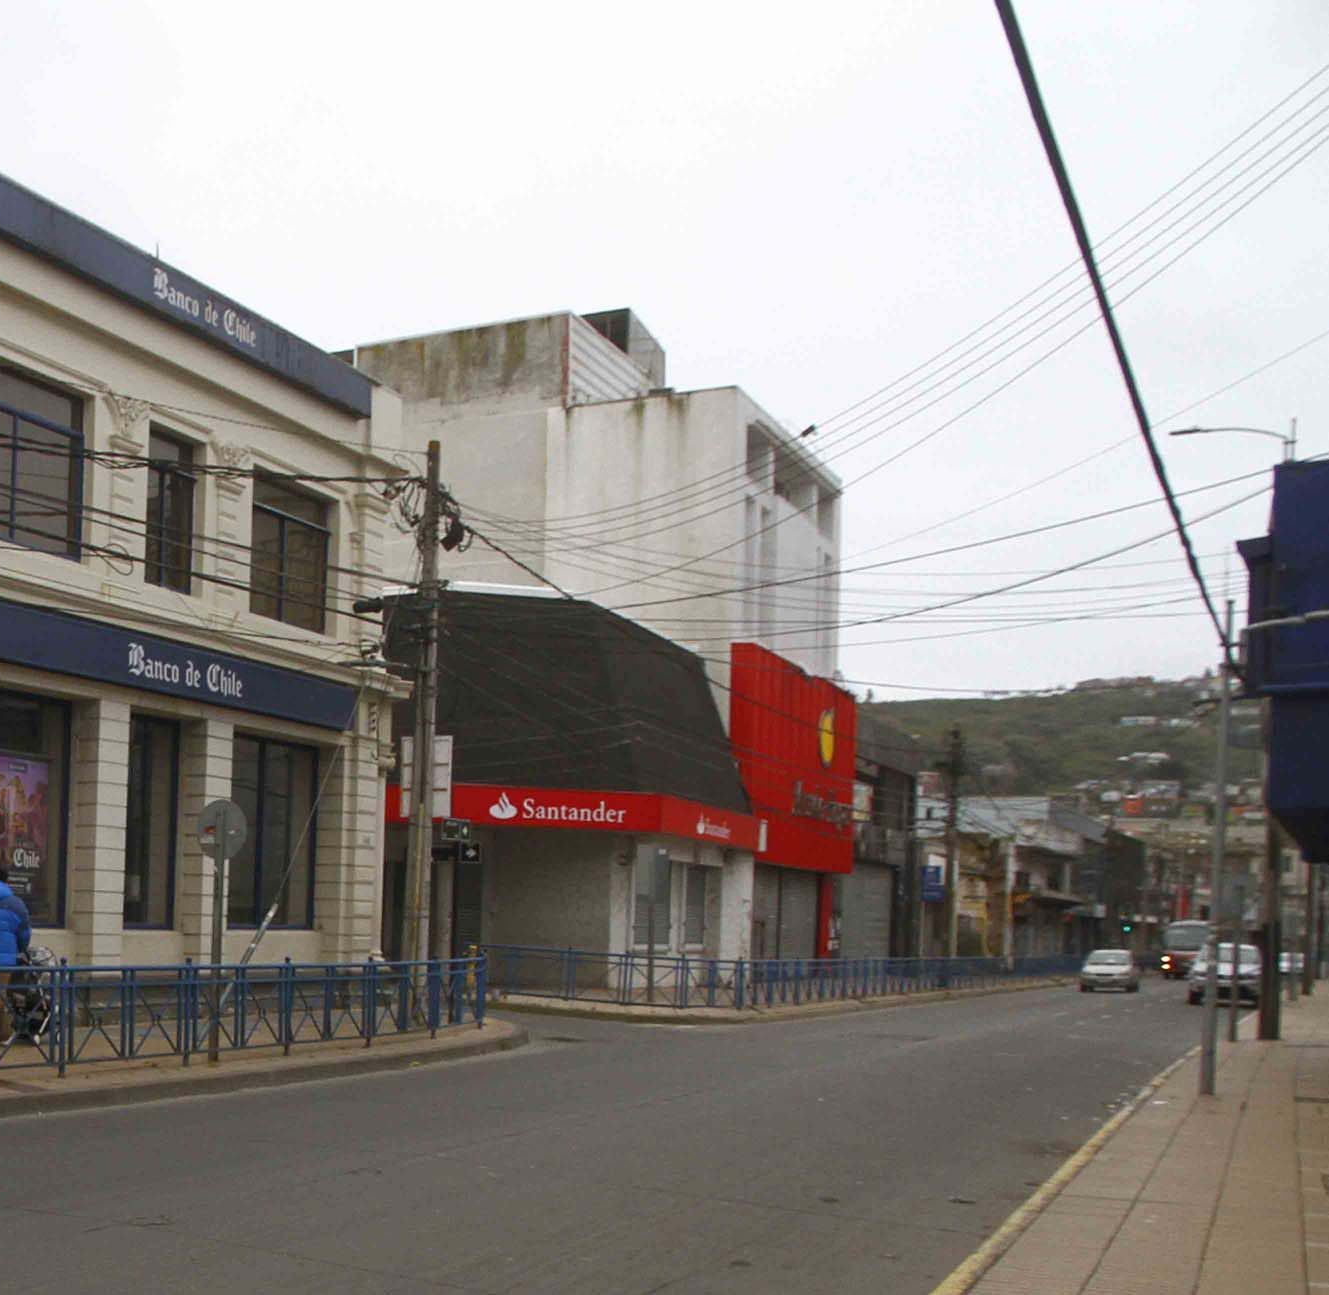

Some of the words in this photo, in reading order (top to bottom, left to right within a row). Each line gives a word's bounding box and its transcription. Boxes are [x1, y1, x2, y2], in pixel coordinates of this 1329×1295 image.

[154, 267, 199, 317] Banco
[205, 300, 218, 327] de
[224, 308, 256, 347] Chile
[128, 643, 179, 684] Banco
[185, 660, 201, 688] de
[207, 663, 243, 698] Chile
[523, 798, 626, 823] Santander
[13, 848, 40, 869] Chile
